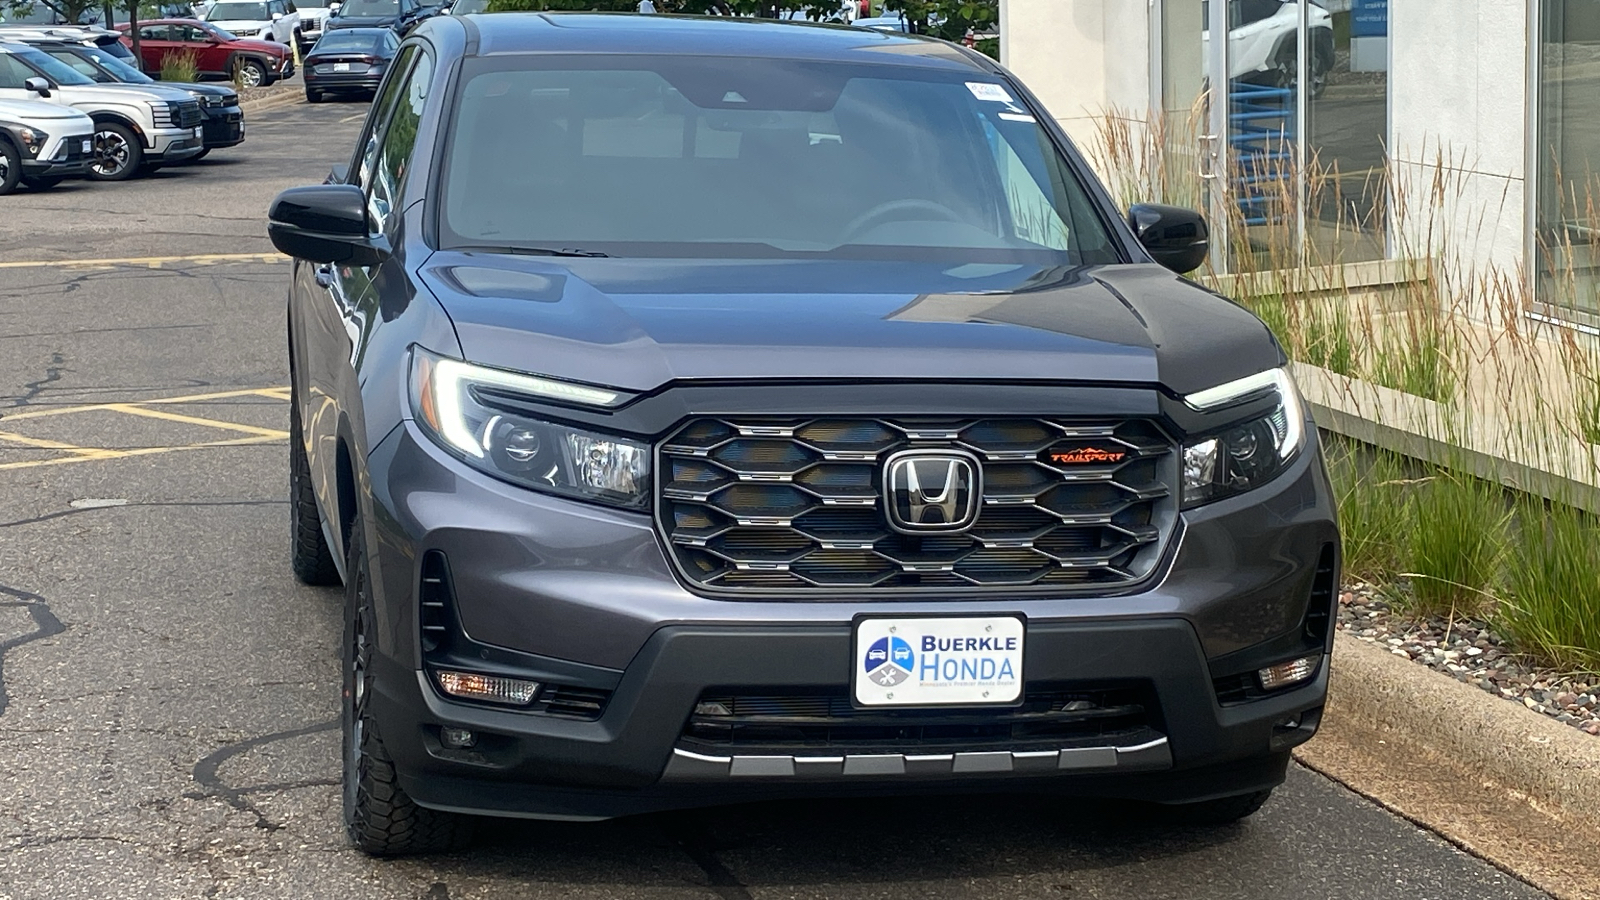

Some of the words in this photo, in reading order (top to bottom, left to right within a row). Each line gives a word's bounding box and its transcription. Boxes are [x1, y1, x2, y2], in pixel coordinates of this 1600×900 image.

[1050, 452, 1125, 463] TRAILSPORT
[921, 635, 1017, 652] BUERKLE
[919, 653, 1015, 681] HONDA
